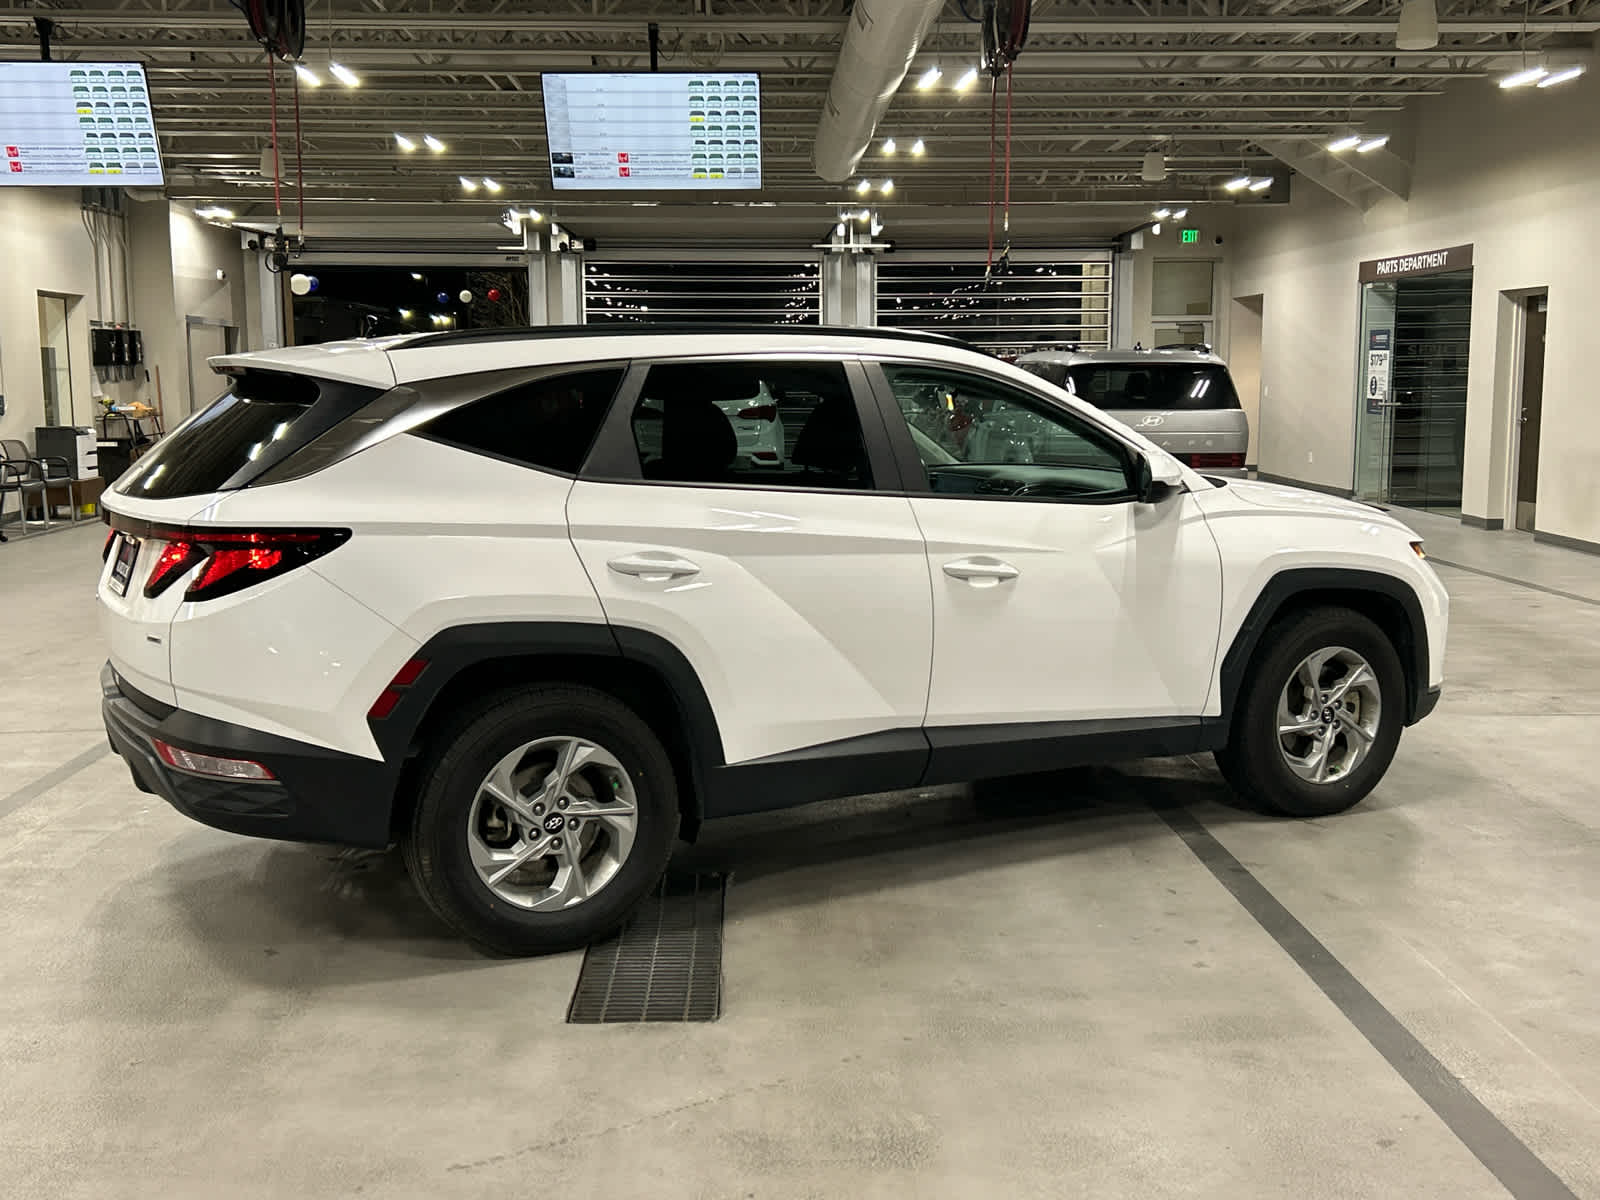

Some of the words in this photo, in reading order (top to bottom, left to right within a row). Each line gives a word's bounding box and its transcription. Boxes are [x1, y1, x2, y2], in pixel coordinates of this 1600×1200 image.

[1182, 230, 1198, 243] EXIT
[1376, 259, 1398, 275] PARTS
[1399, 251, 1449, 273] DEPARTMENT
